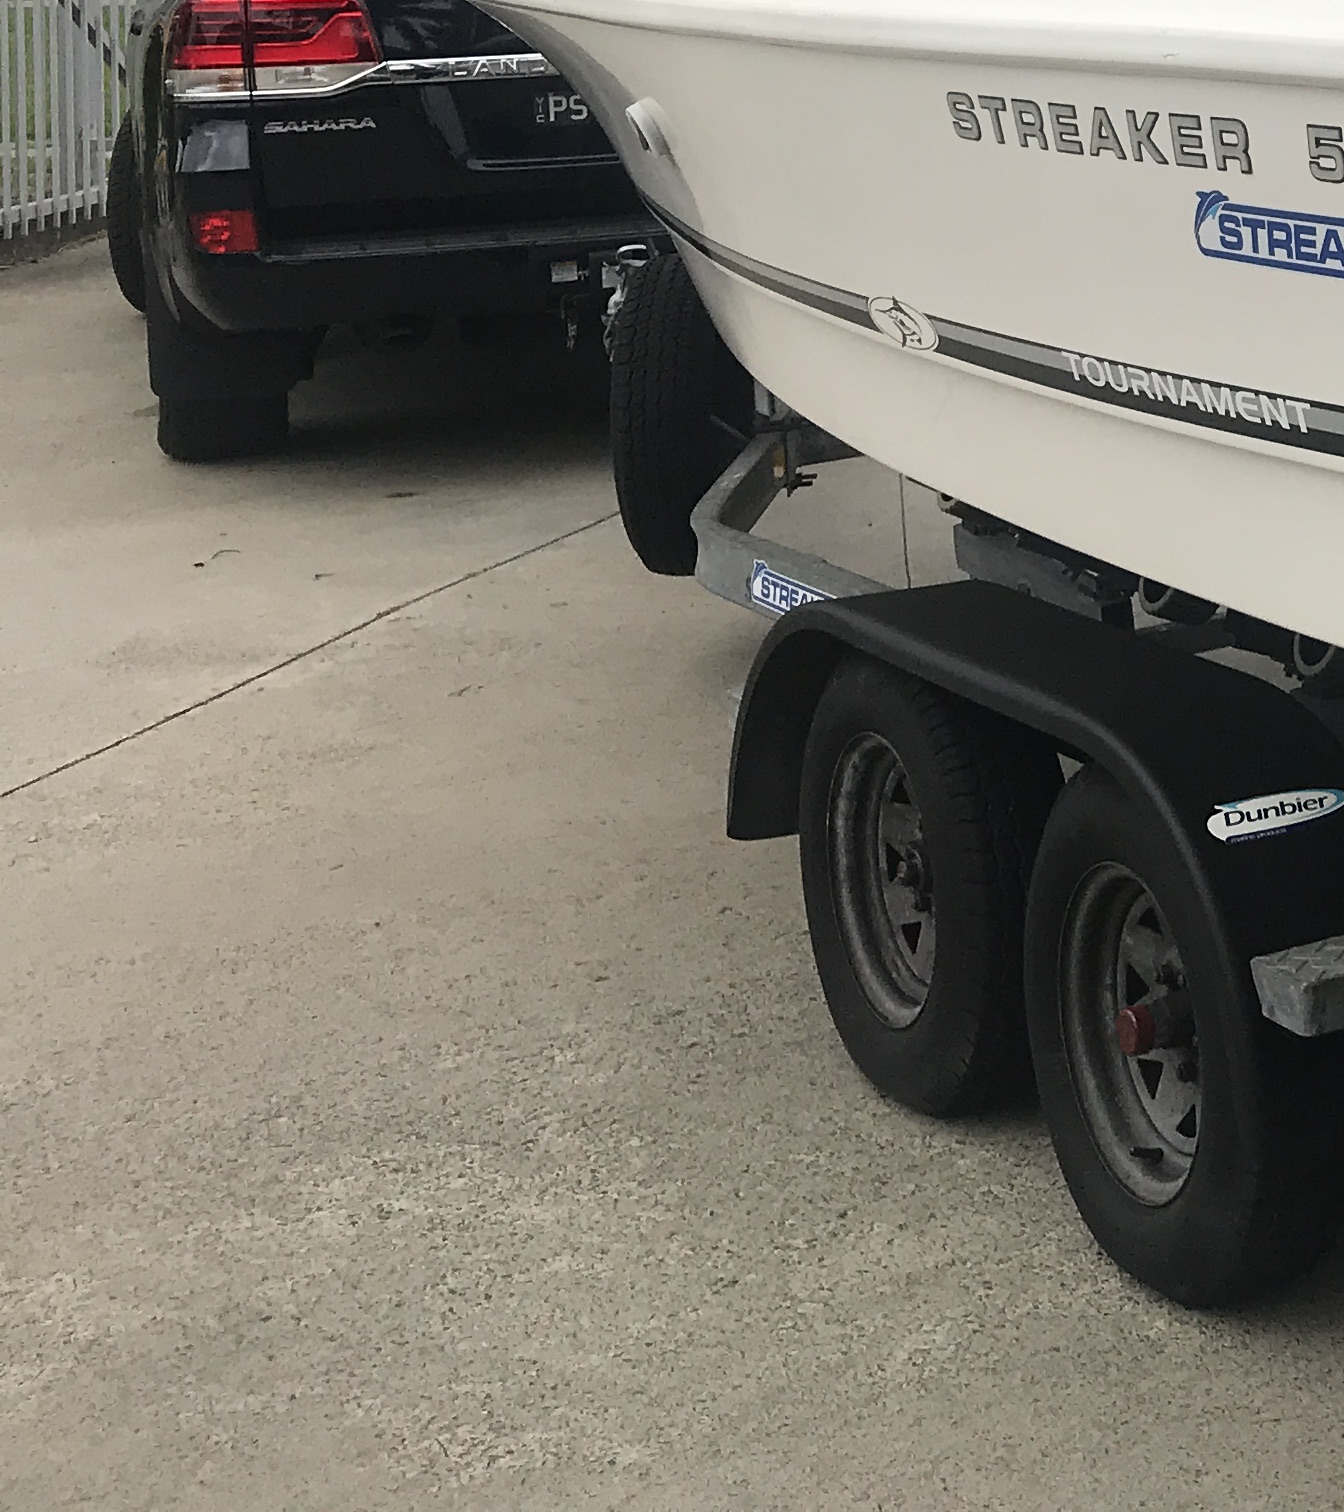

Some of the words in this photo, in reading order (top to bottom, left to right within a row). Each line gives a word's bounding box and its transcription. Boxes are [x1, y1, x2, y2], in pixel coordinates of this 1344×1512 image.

[549, 93, 588, 122] PS
[264, 117, 376, 134] SAHARA
[946, 90, 1253, 175] STREAKER
[1061, 350, 1311, 433] TOURNAMENT
[1224, 795, 1328, 827] Dunbier
